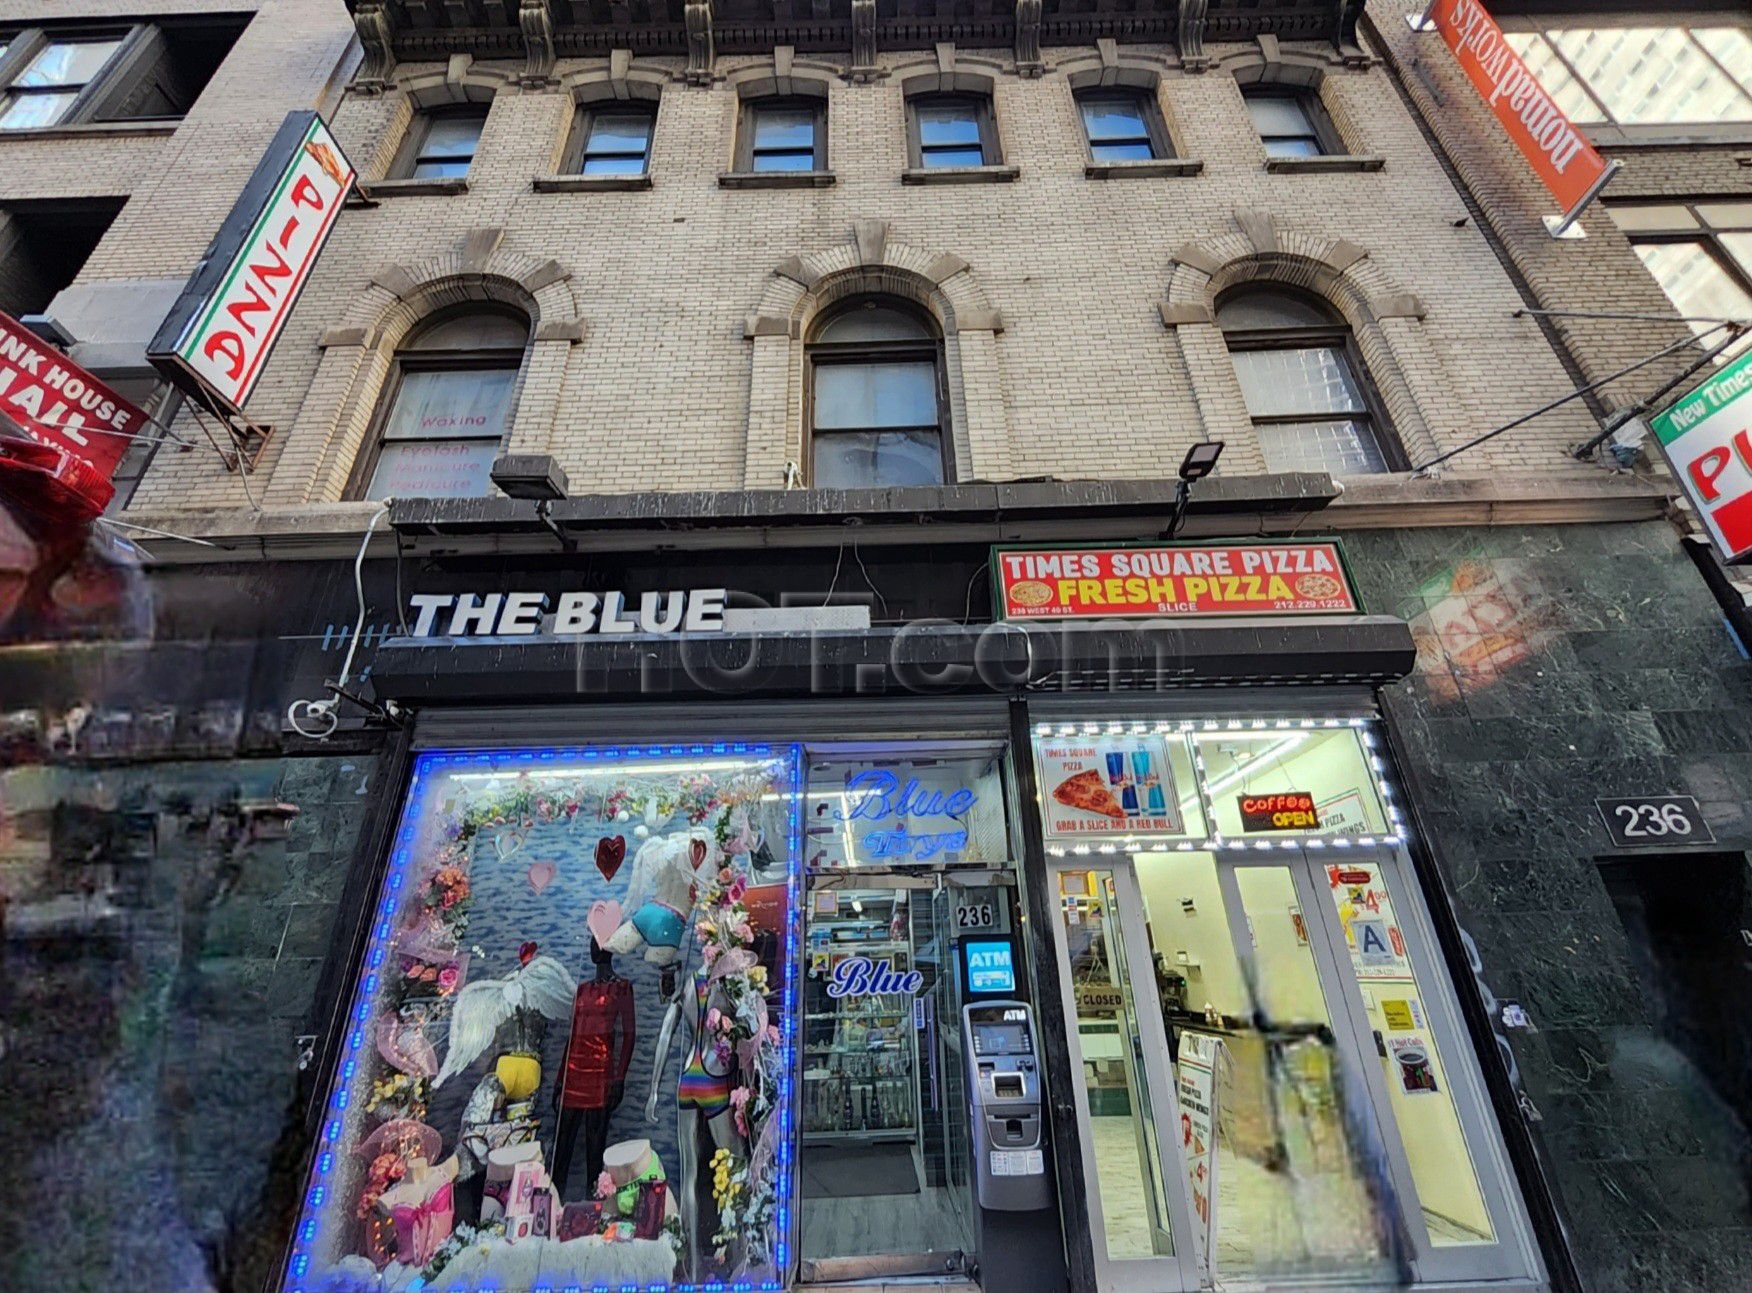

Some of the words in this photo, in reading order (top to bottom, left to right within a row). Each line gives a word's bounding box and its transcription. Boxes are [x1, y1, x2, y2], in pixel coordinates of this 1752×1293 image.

[1449, 0, 1584, 175] nomadworks
[42, 364, 132, 431] HOUSE
[1669, 399, 1707, 432] New
[1006, 555, 1100, 579] TIMES
[1111, 552, 1232, 578] SQUARE
[1242, 550, 1334, 574] PIZZA
[1058, 576, 1176, 605] FRESH
[1185, 575, 1294, 602] PIZZA
[410, 593, 549, 637] THE
[552, 588, 727, 634] BLUE
[1026, 606, 1049, 615] WEST
[1158, 602, 1198, 612] SLICE
[1045, 748, 1067, 758] TIMES
[1069, 747, 1097, 757] SQUARE
[1062, 761, 1083, 771] PIZZA
[833, 769, 979, 820] Blue
[1056, 820, 1077, 831] GRAB
[1079, 820, 1085, 830] A
[1087, 820, 1108, 831] SLICE
[1110, 819, 1127, 830] AND
[1129, 820, 1135, 829] A
[1136, 819, 1152, 829] RED
[1153, 819, 1173, 829] BULL
[1272, 810, 1315, 827] OPEN
[1615, 803, 1692, 837] 236
[957, 905, 992, 927] 236
[1363, 925, 1387, 953] A
[969, 950, 1011, 968] ATM
[827, 956, 924, 998] Blue
[1082, 994, 1122, 1006] CLOSED
[1003, 1009, 1027, 1021] ATM
